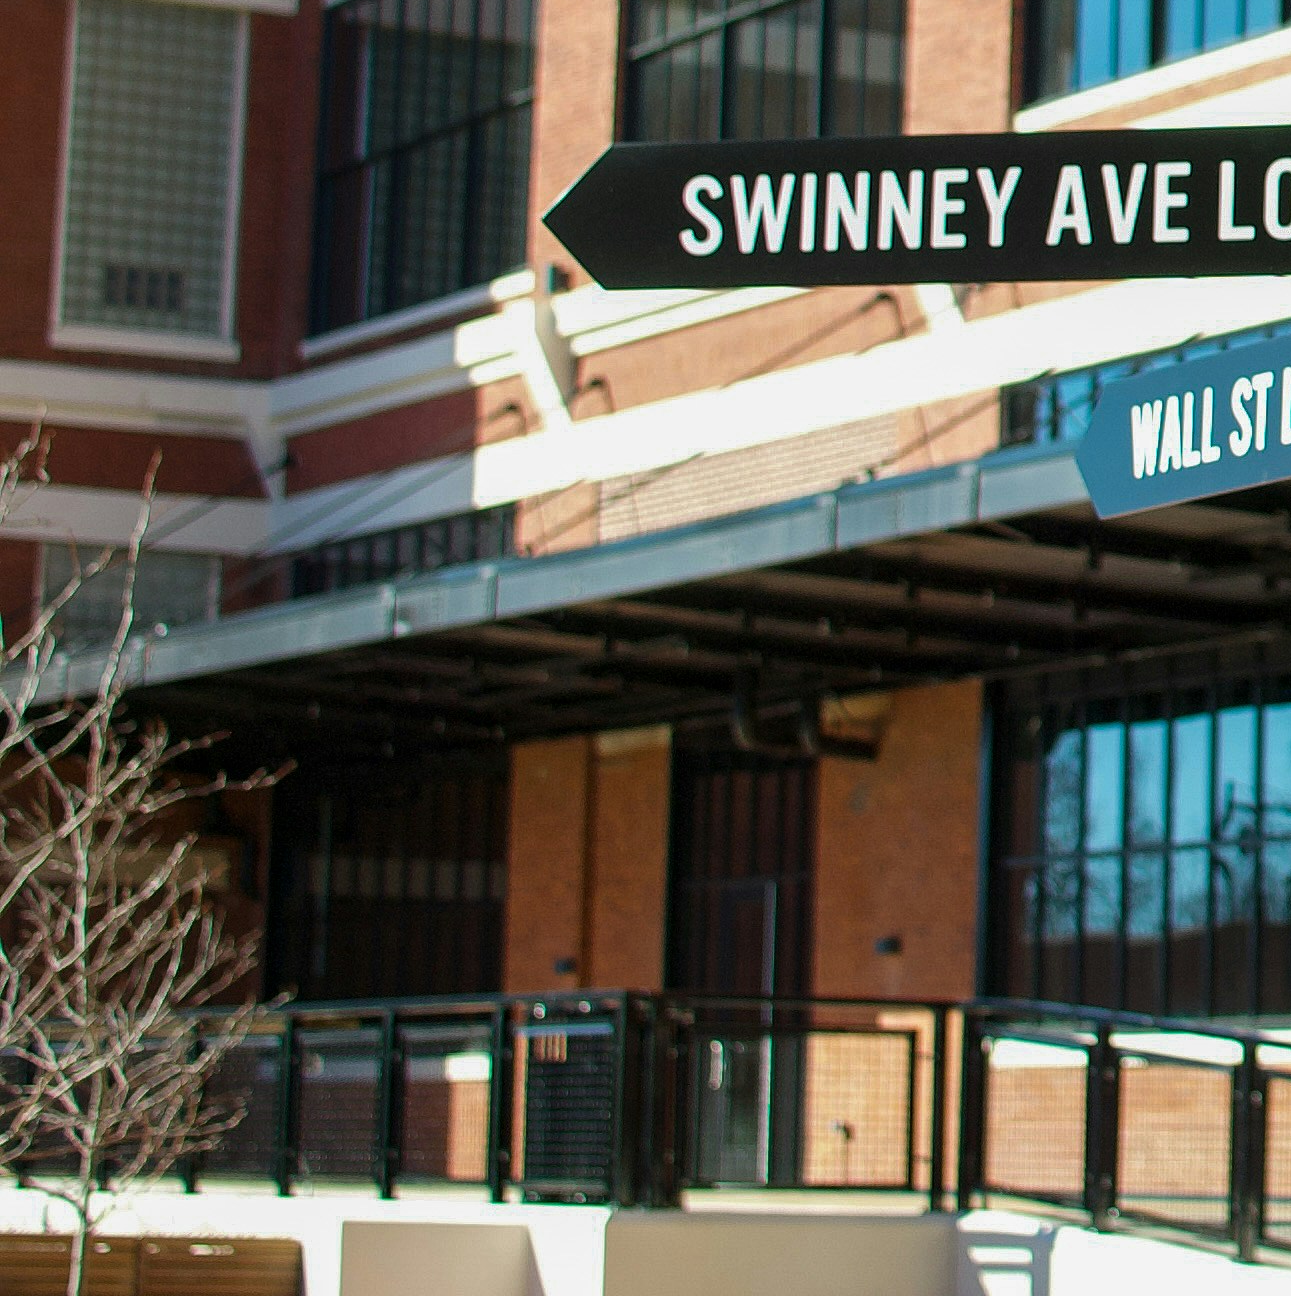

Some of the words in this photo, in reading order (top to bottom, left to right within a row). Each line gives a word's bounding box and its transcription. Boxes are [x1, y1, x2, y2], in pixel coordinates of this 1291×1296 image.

[679, 167, 1022, 257] SWINNEY
[1046, 161, 1192, 246] AVE
[1130, 387, 1221, 479] WALL
[1229, 371, 1274, 457] ST
